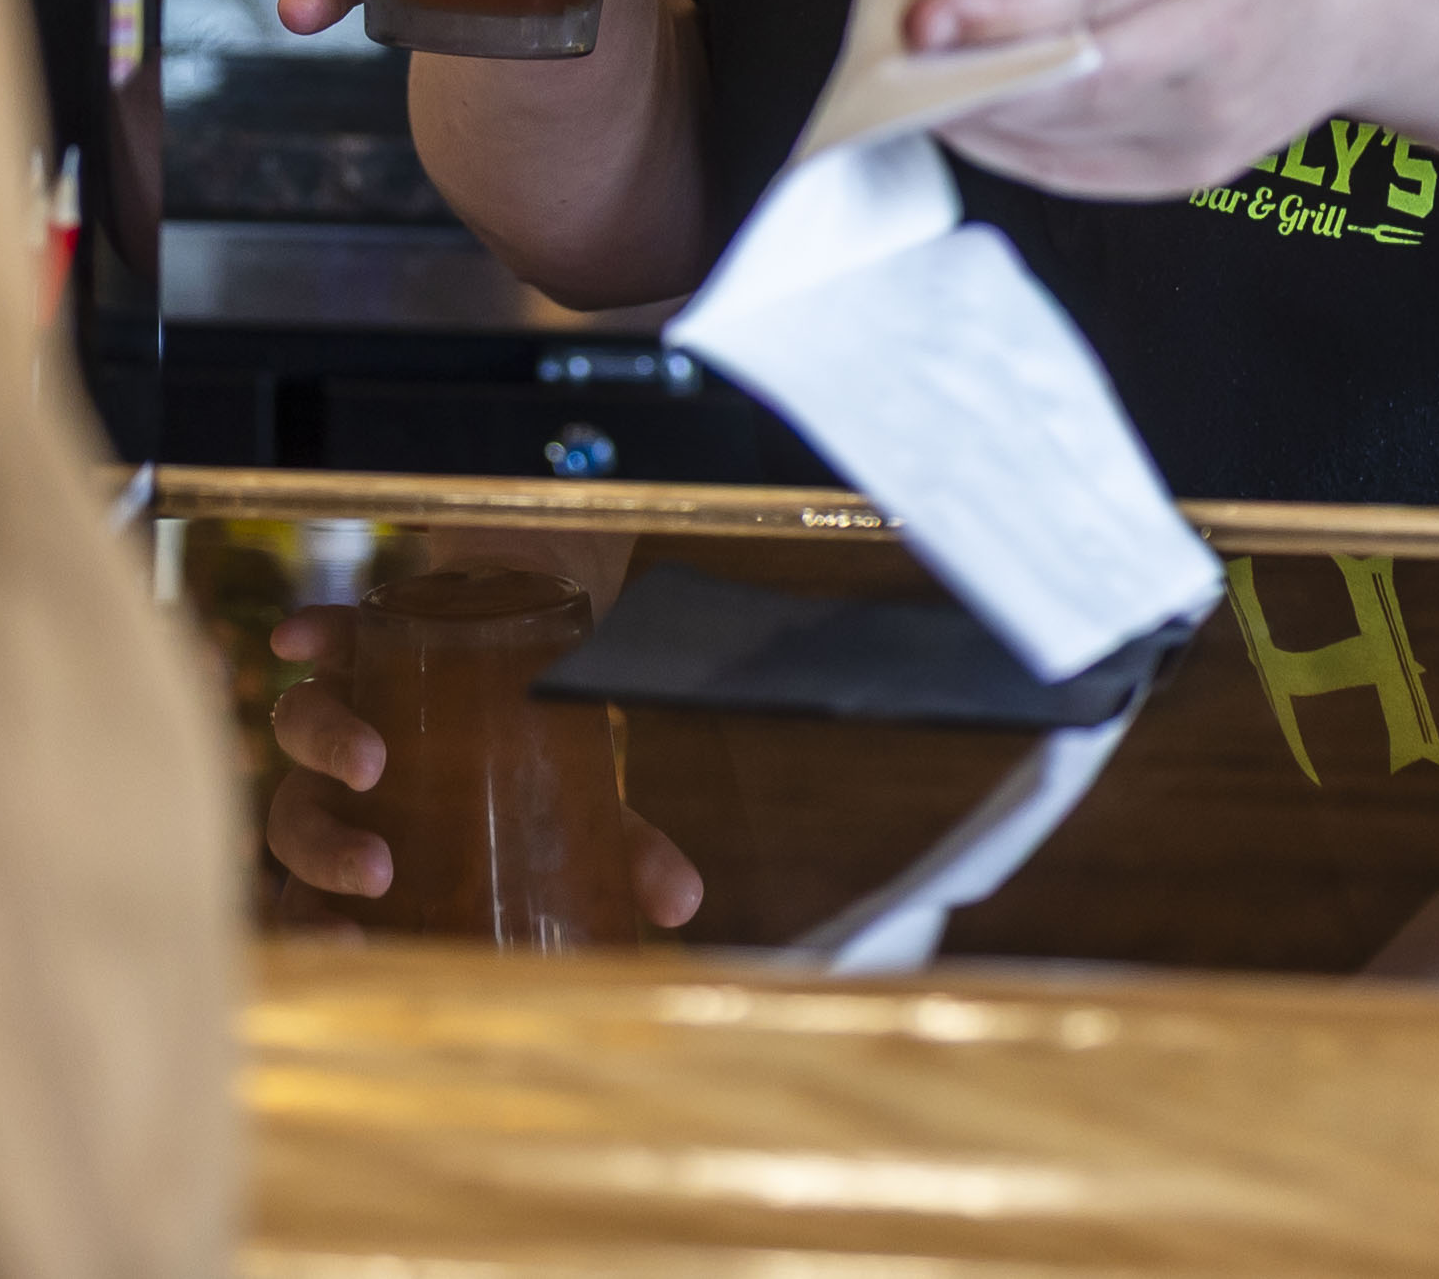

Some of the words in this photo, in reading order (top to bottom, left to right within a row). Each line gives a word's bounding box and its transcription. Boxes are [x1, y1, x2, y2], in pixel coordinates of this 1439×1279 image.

[1247, 119, 1438, 219] LY'S
[1248, 186, 1277, 220] &
[1278, 194, 1347, 239] Grill
